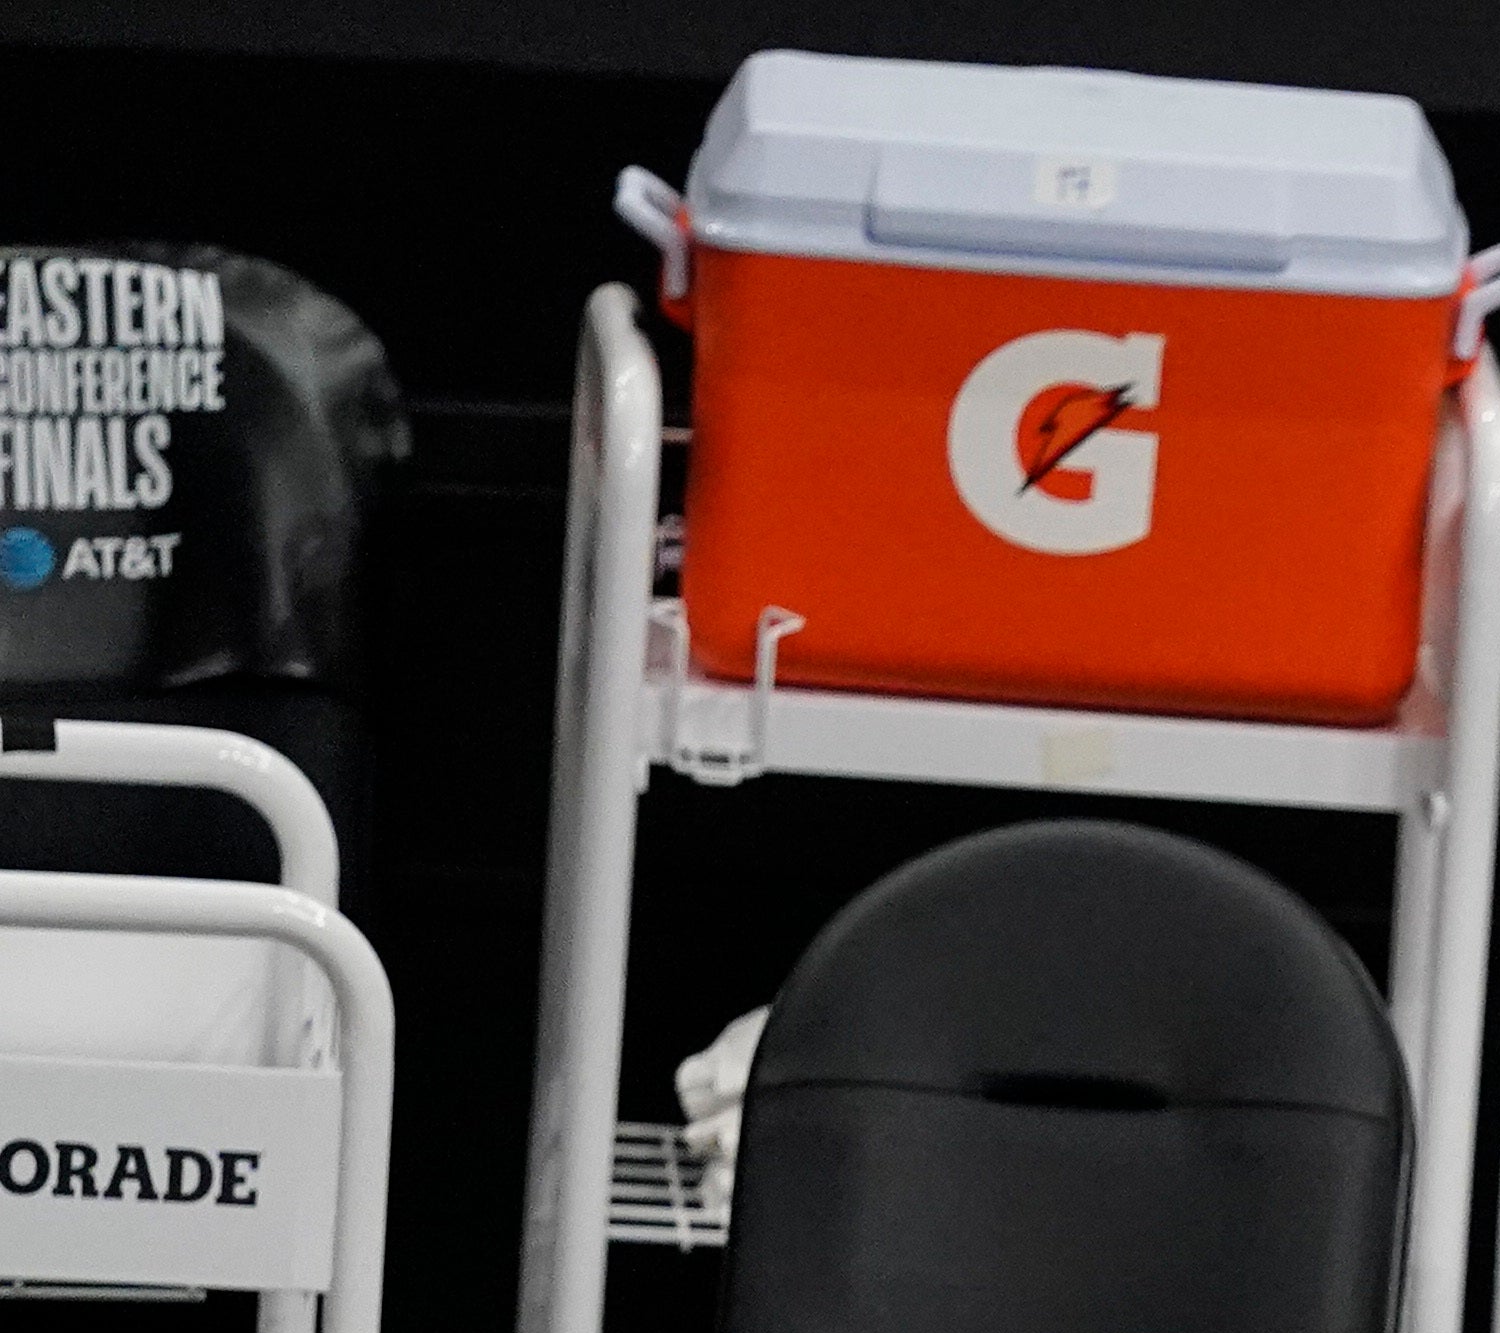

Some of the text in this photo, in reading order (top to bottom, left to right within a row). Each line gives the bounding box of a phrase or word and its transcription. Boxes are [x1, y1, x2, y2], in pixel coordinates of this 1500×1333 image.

[0, 257, 224, 349] ASTERN
[946, 328, 1164, 556] G
[61, 533, 182, 581] AT&T
